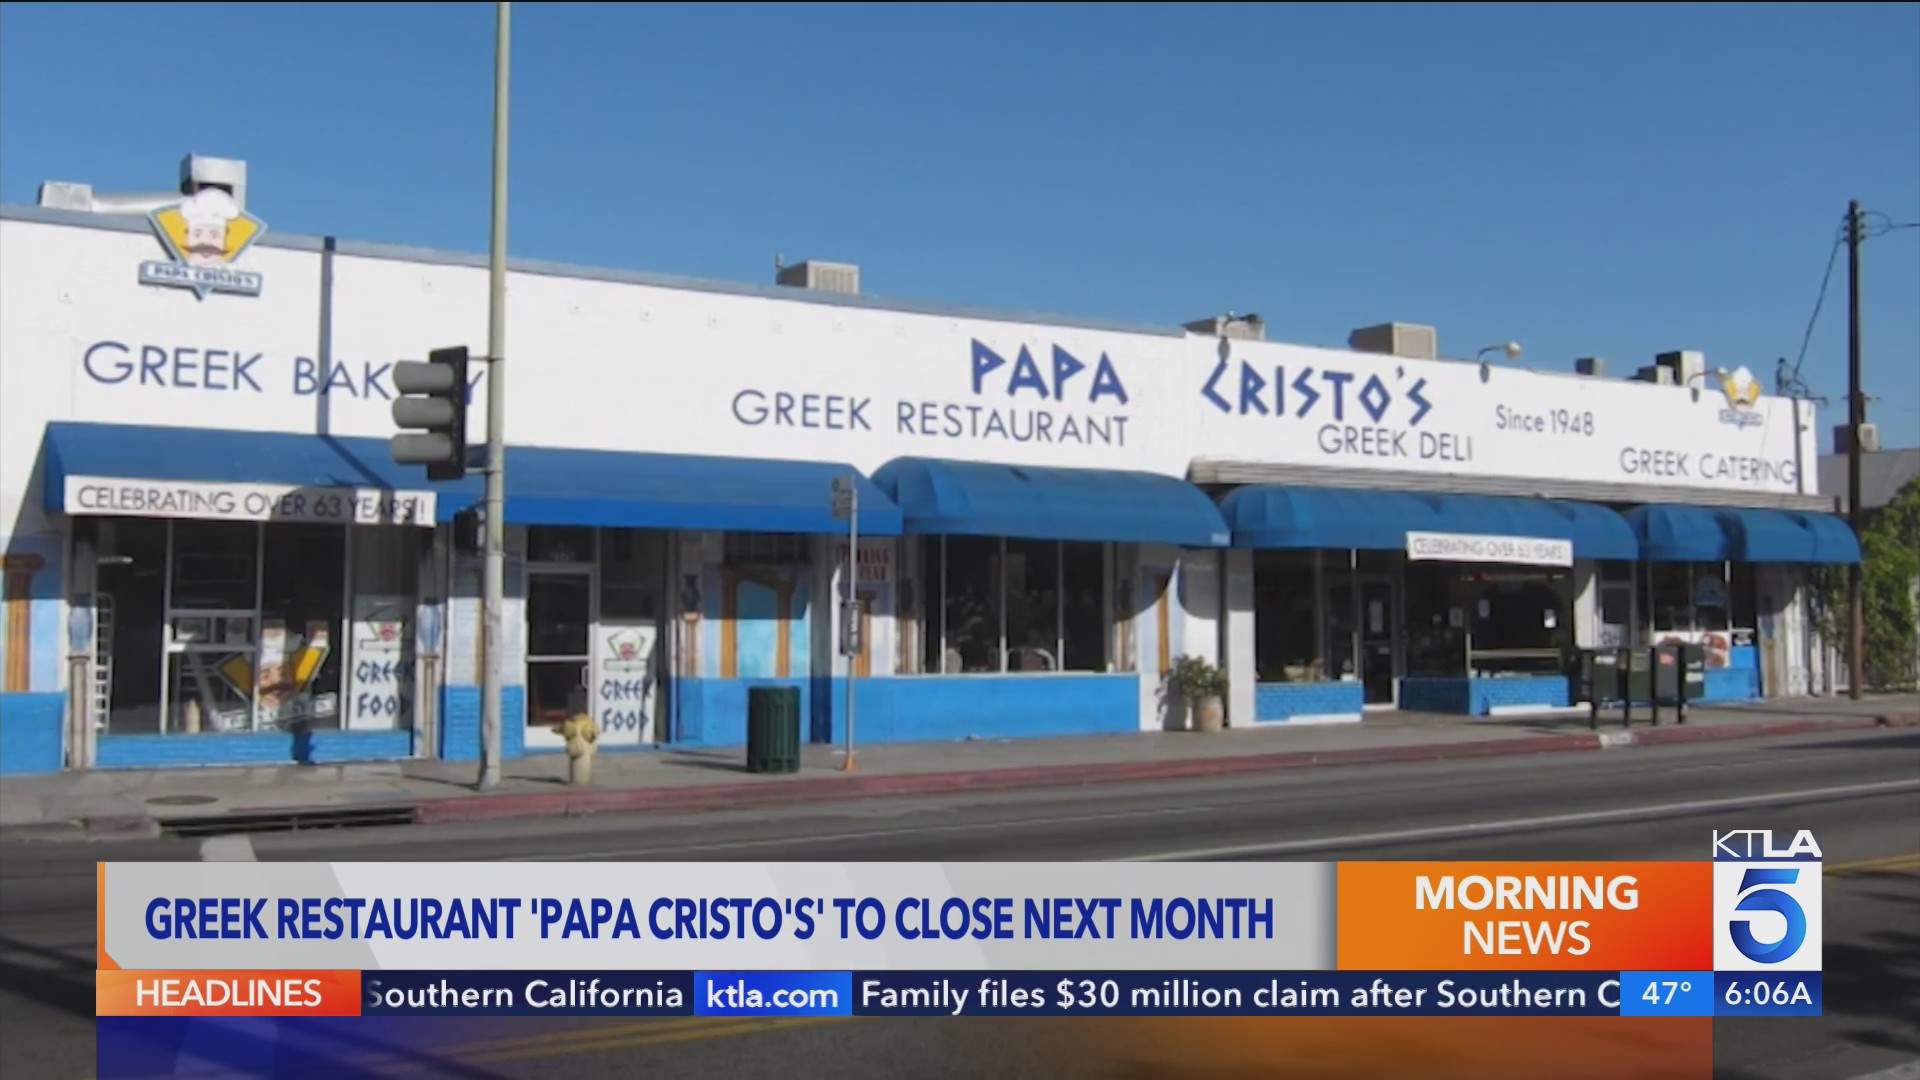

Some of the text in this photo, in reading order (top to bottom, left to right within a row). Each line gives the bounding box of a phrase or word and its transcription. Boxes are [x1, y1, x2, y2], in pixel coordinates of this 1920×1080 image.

[83, 341, 484, 405] GREEK BAKY
[971, 337, 1433, 427] PAPA CRISTO'S
[732, 389, 1129, 447] GREEK RESTAURANT
[1496, 404, 1594, 437] Since 1948
[1318, 424, 1473, 461] GREEK DELI
[1620, 447, 1797, 484] GREEK CATERING
[78, 484, 236, 514] CELEBRATING
[244, 492, 305, 517] OVER
[313, 494, 340, 518] 63
[600, 678, 653, 701] GREEK
[602, 708, 650, 733] FOOD
